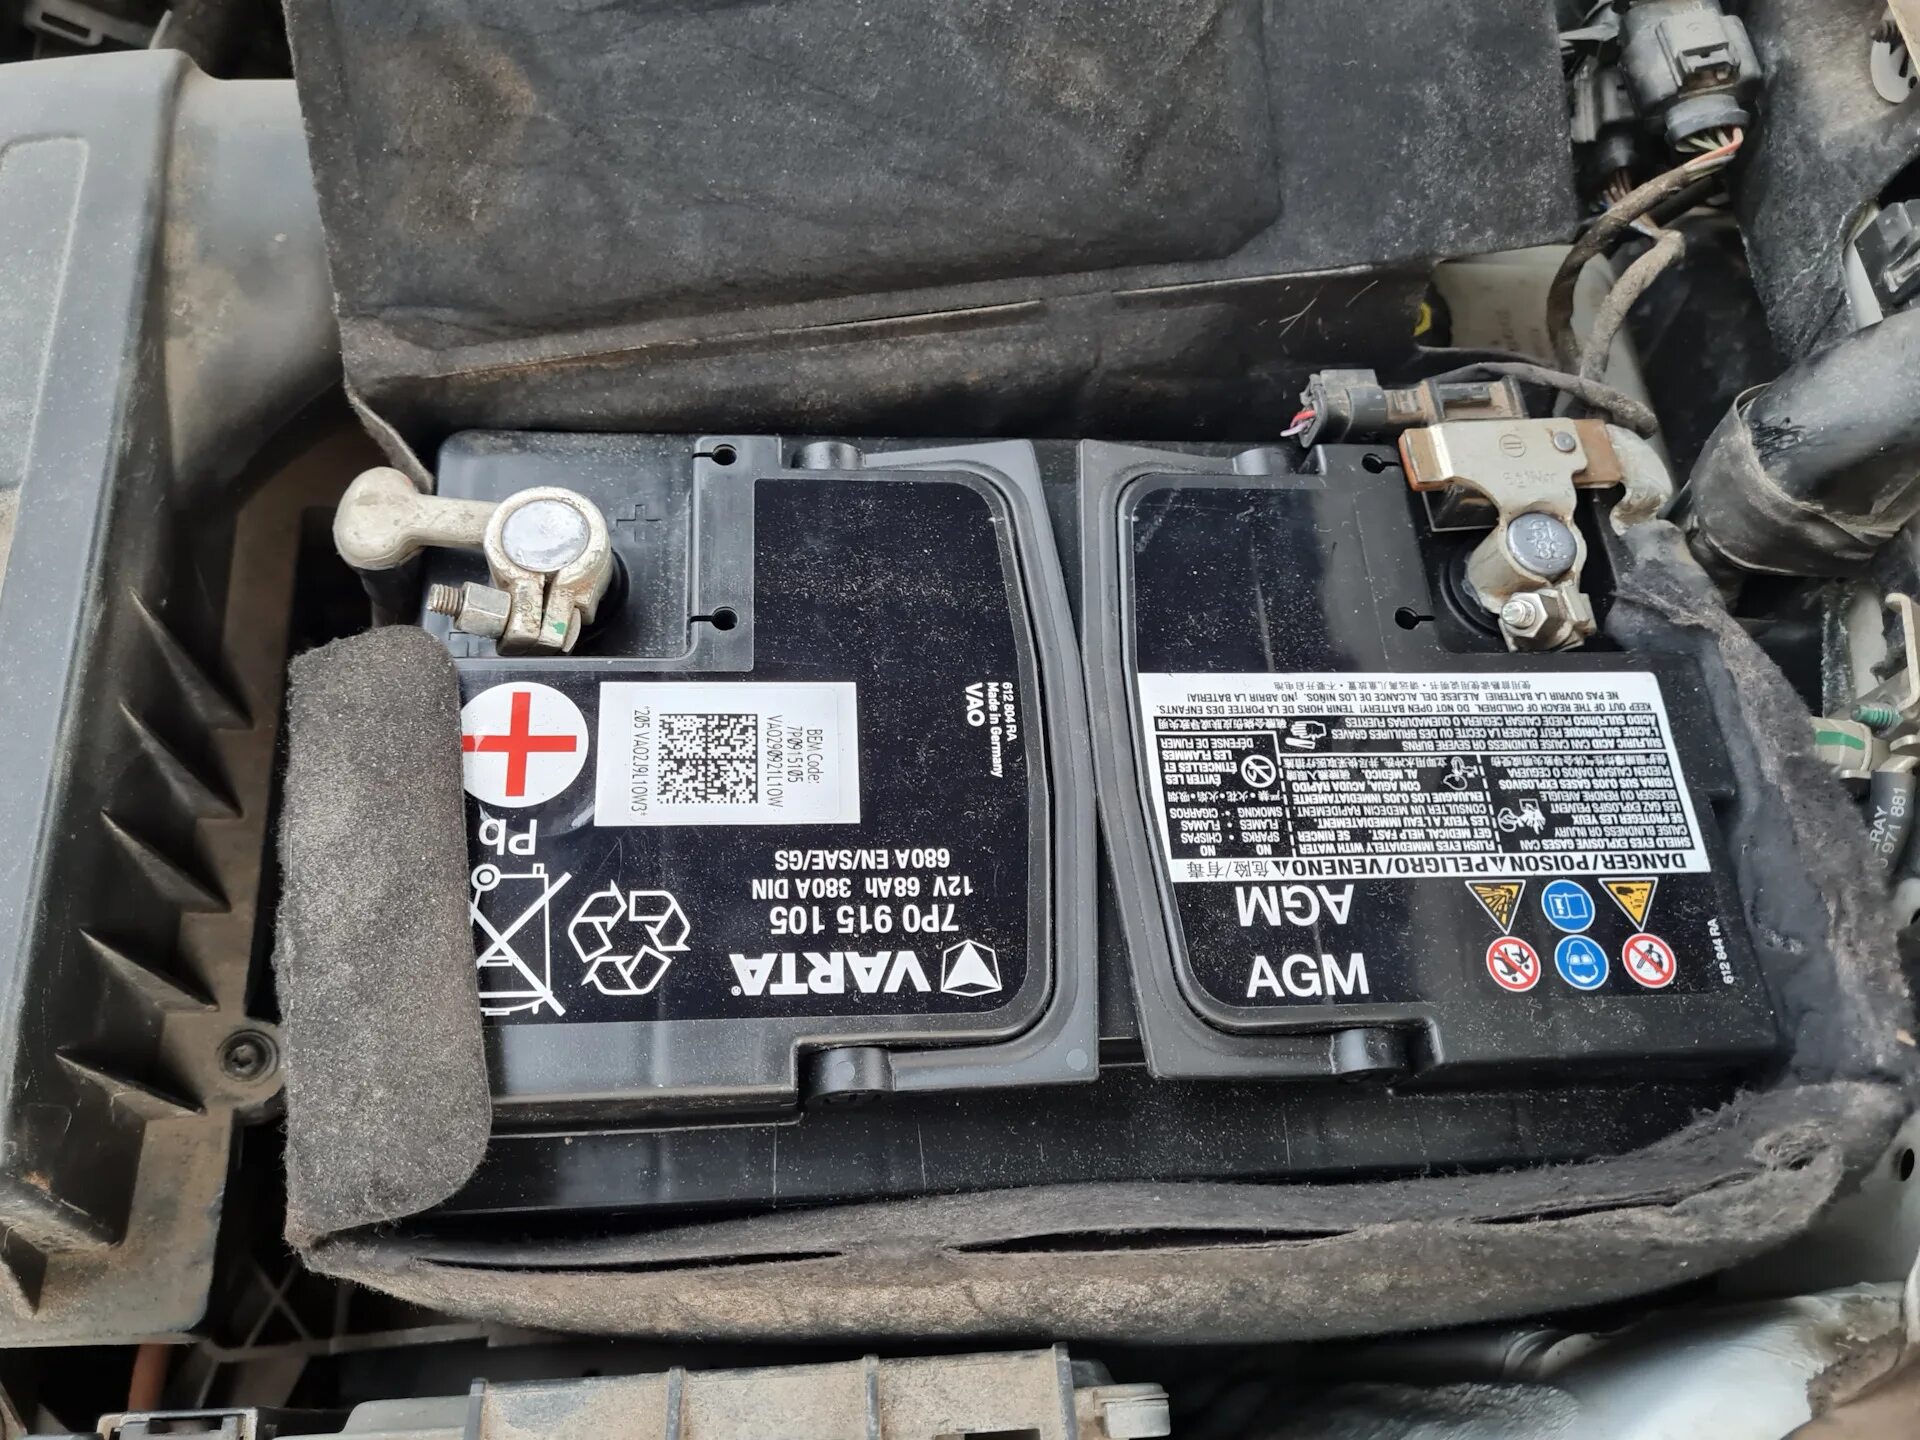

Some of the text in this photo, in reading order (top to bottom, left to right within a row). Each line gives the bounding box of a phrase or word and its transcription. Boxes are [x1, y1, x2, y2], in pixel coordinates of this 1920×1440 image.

[1002, 682, 1014, 701] 612
[1186, 691, 1619, 701] NE PAS OUVRIR LA BATTERIE! ALEJESE DEL ALCANCE DE LOS NIÑOS. ¡NO ABRIR LA BATERIA!
[965, 682, 985, 727] VAO
[1155, 702, 1651, 713] KEEP OUT OF THE REACH OF CHILDREN. DO NOT OPEN BATTERY! TENIR HORS DE LA PORTEE DES ENFANTS.
[987, 682, 1003, 778] Made in Germany
[1006, 724, 1018, 742] RA
[1159, 737, 1254, 749] DÉFENSE DE FUMER
[1401, 737, 1663, 750] SULFURIC ACID CAN CAUSE BLINDNESS OR SEVERE BURNS
[806, 729, 824, 784] BEM Code:
[1161, 749, 1232, 760] LES FLAMMES
[1162, 761, 1237, 774] ÉTINCELLES ET
[1361, 768, 1403, 779] MÉDICO.
[1403, 768, 1418, 779] AL
[1506, 765, 1671, 778] PUEDEN CAUSAR DAÑOS O CEGUERA
[1164, 774, 1221, 785] ÉVITER LES
[1291, 780, 1421, 792] CON AGUA, ACUDA RÁPIDO
[1291, 792, 1484, 804] ENJUAGUE LOS OJOS INMEDIATAMENTE
[1539, 789, 1677, 801] BLESSER OU RENDRE AVEUGLE
[1548, 801, 1681, 812] LES GAZ EXPLOSIFS PEUVENT
[1890, 787, 1907, 817] 881
[1169, 806, 1283, 818] SMOKING CIGARROS
[1292, 803, 1487, 816] CONSULTER UN MEDECIN RAPIDEMENT.
[1180, 818, 1278, 830] FLAMES FLAMAS
[1313, 815, 1489, 828] LES YEUX A L'EAU IMMEDIATEMENT.
[1571, 812, 1684, 824] SE PROTEGER LES YEUX
[479, 819, 537, 855] Pb
[1180, 831, 1280, 843] SPARKS CHISPAS
[1296, 827, 1492, 841] GET MEDICAL HELP FAST. SE RINCER
[1552, 824, 1688, 837] CAUSE BLINDNESS OR INJURY
[1519, 836, 1691, 849] SHIELD EYES EXPLOSIVE GASES CAN
[1881, 824, 1901, 853] 971
[1199, 844, 1216, 856] NO
[1255, 843, 1272, 855] NO
[1298, 840, 1495, 853] FLUSH EYES IMMEDIATELY WITH WATER
[774, 848, 951, 871] 680A EN/SAE/GS
[1289, 852, 1687, 876] DANGER/POISON PELIGRO/VENENO
[752, 876, 974, 900] 12V 68Ah 380A DIN
[1235, 884, 1354, 926] AGM
[769, 904, 960, 935] 7P0 915 105
[1707, 918, 1734, 984] 612 844 RA
[728, 951, 933, 996] VARTA
[1247, 953, 1369, 998] AGM
